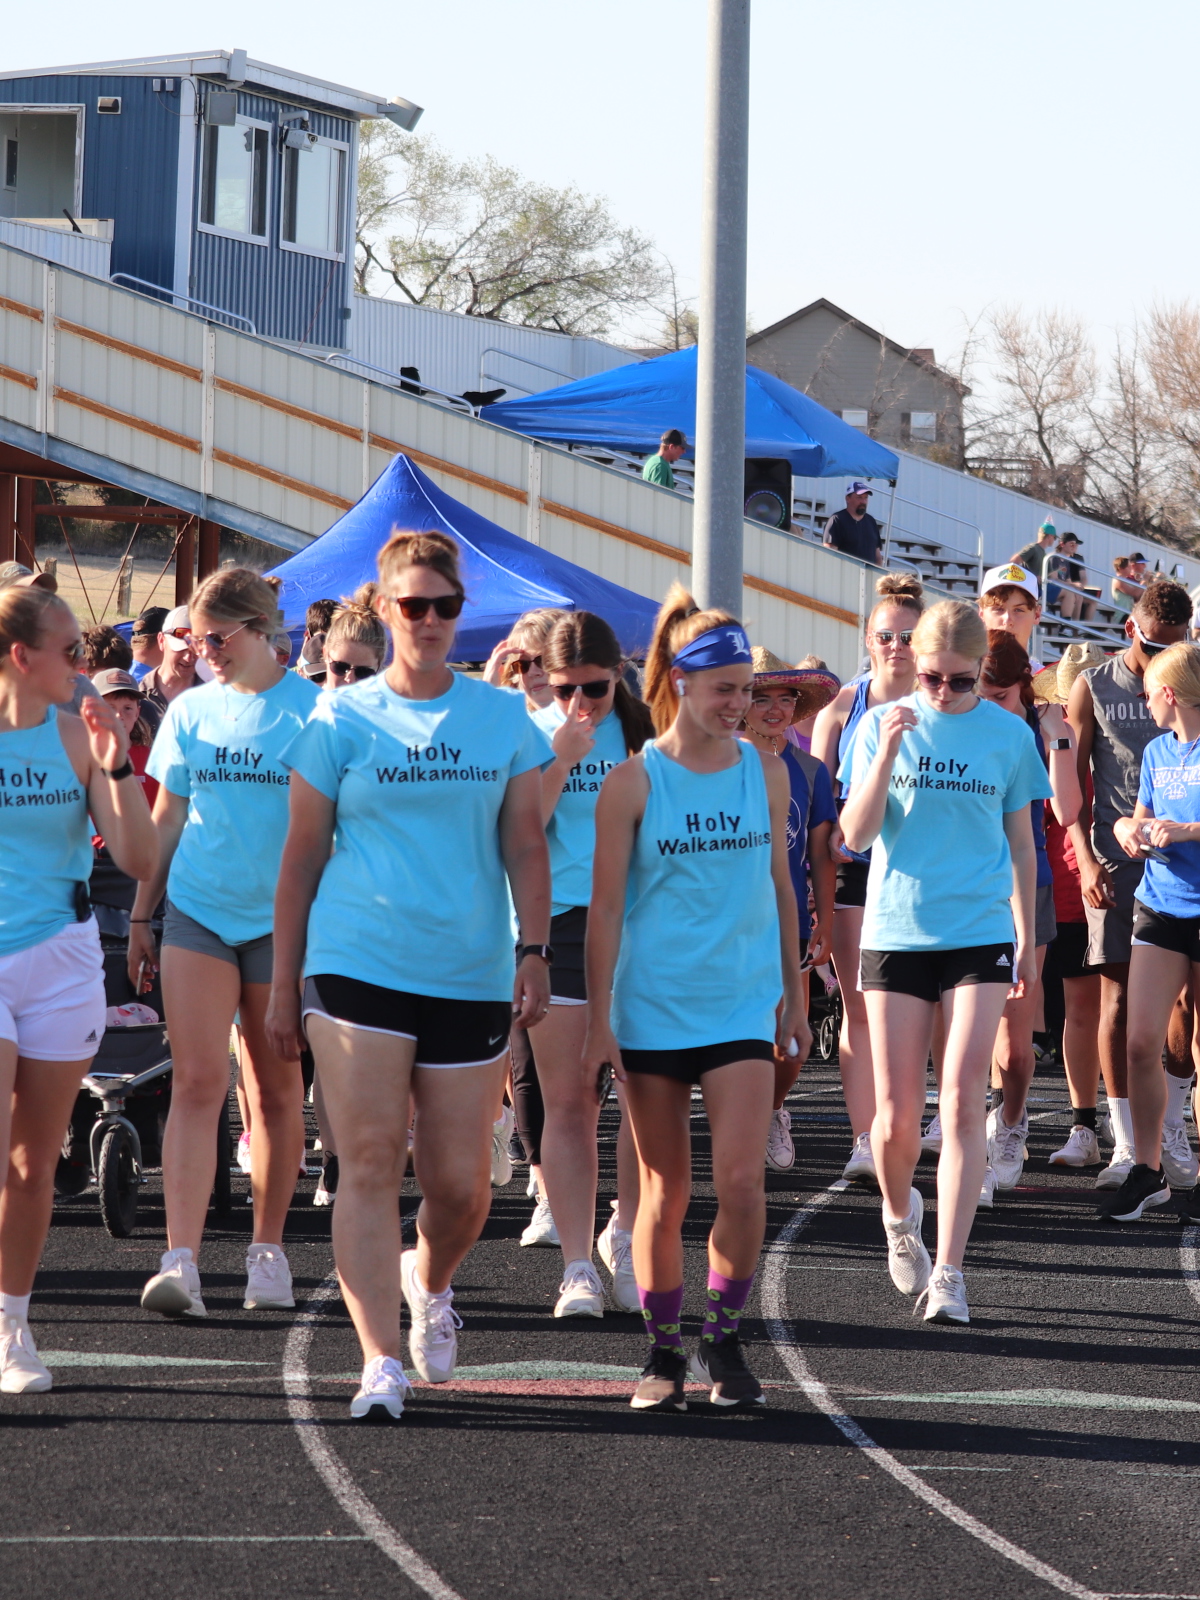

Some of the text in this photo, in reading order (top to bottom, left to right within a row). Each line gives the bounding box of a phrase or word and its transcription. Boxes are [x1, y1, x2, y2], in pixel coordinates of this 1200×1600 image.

[215, 746, 263, 769] Holy
[406, 742, 461, 764] Holy
[376, 765, 499, 784] Walkamolies
[918, 755, 969, 778] Holy
[561, 778, 604, 793] alka
[891, 774, 997, 796] Walkamolies
[686, 811, 741, 834] Holy
[656, 831, 772, 856] Walkamolies
